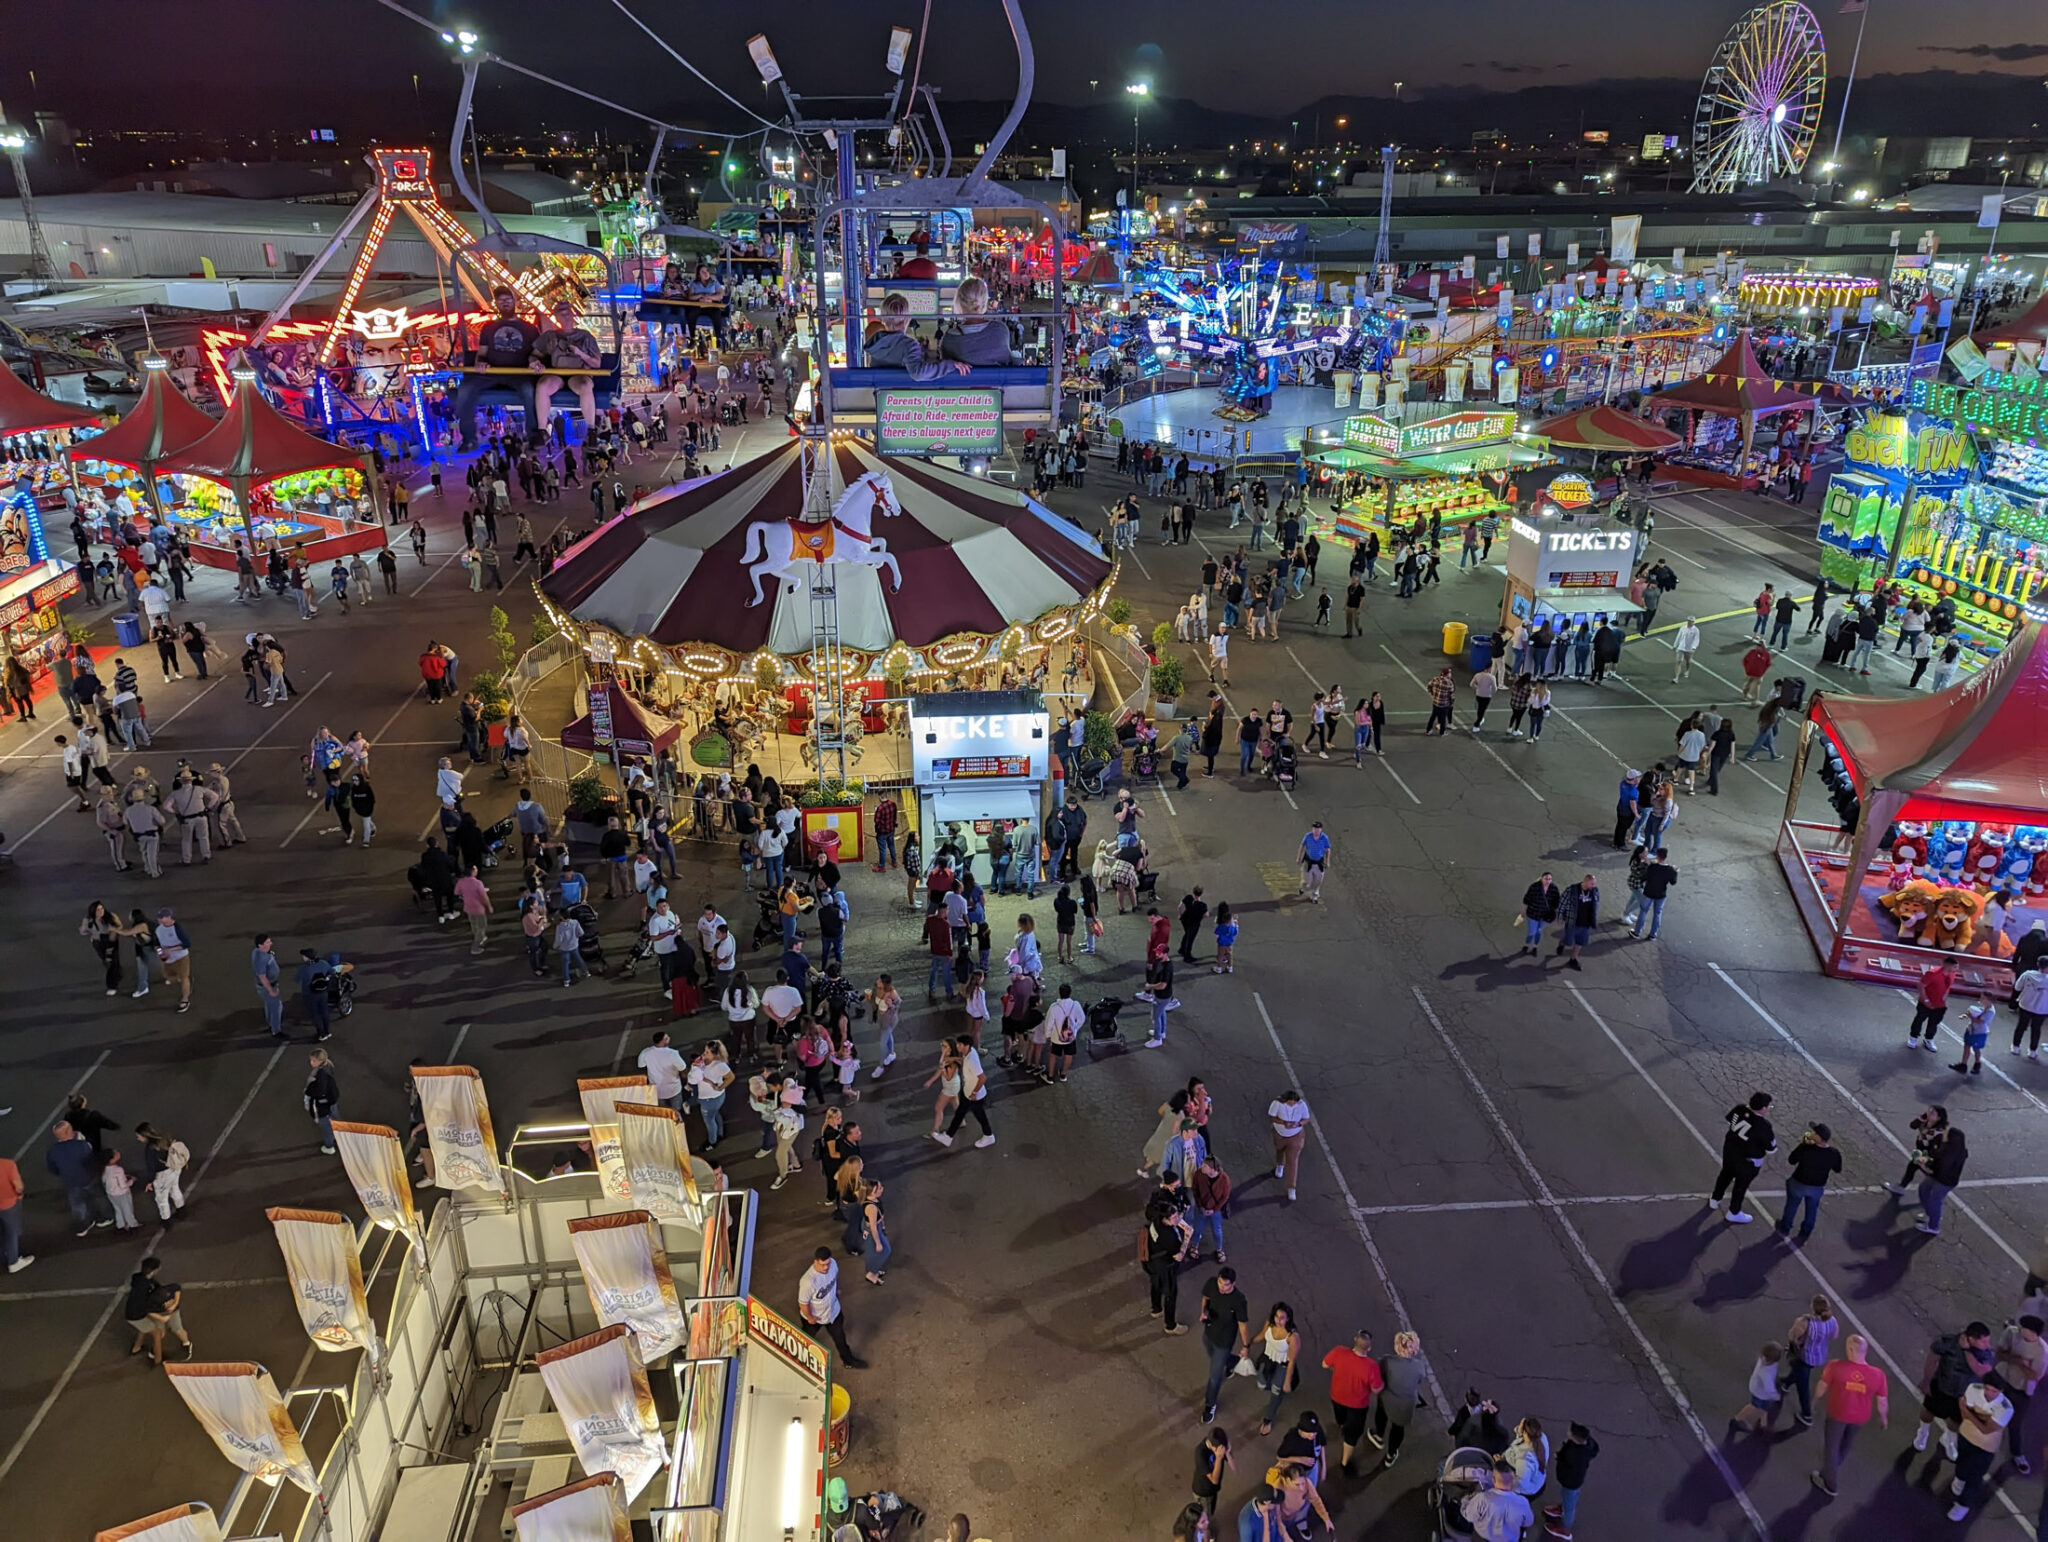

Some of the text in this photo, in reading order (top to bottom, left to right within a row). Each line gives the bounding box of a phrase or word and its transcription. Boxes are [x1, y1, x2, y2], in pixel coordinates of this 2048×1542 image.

[393, 160, 417, 179] G
[391, 181, 425, 192] FORCE
[1244, 228, 1299, 242] Hangout
[887, 395, 993, 407] Parents if your Child is
[1912, 379, 1956, 416] BIG
[881, 411, 998, 422] Afraid to Ride, remember
[1865, 407, 1904, 437] WIN
[883, 427, 996, 439] there is always next year
[1350, 420, 1398, 438] WINNER
[1409, 417, 1505, 447] WATER GUN FUN
[1850, 432, 1903, 467] BIG!
[1915, 426, 1969, 474] FUN
[1553, 490, 1590, 502] TICKETS
[1511, 517, 1541, 544] TICKETS
[1549, 531, 1632, 551] TICKETS
[1904, 527, 1932, 558] ALL
[0, 553, 30, 573] OREOS
